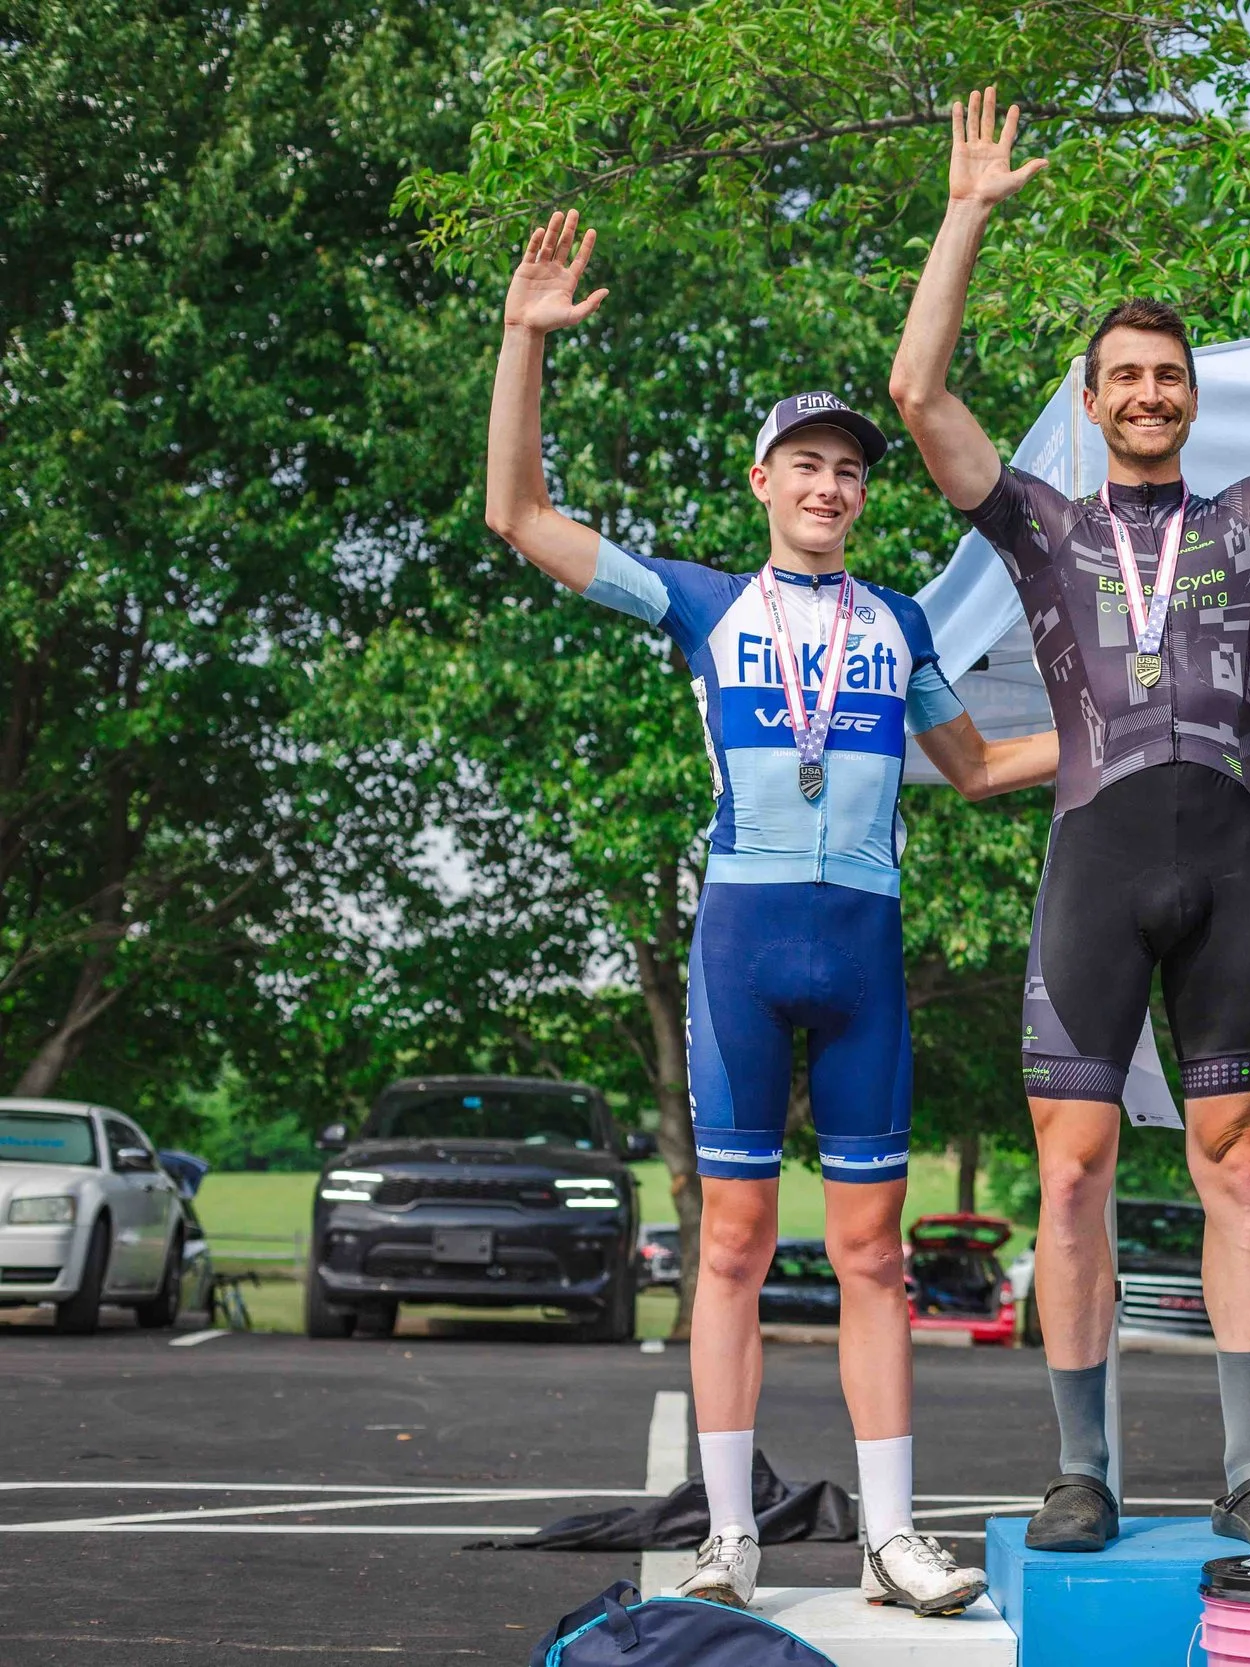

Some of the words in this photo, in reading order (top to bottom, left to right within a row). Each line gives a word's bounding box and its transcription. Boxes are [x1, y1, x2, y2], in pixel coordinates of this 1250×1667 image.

[796, 393, 850, 411] FinKra
[1179, 540, 1215, 556] NDURA
[1175, 568, 1226, 591] Cycle
[1100, 591, 1228, 614] cohing
[773, 612, 783, 633] CYCLING
[738, 631, 898, 693] FiKaft
[754, 708, 882, 733] VEGE
[801, 768, 821, 776] USA
